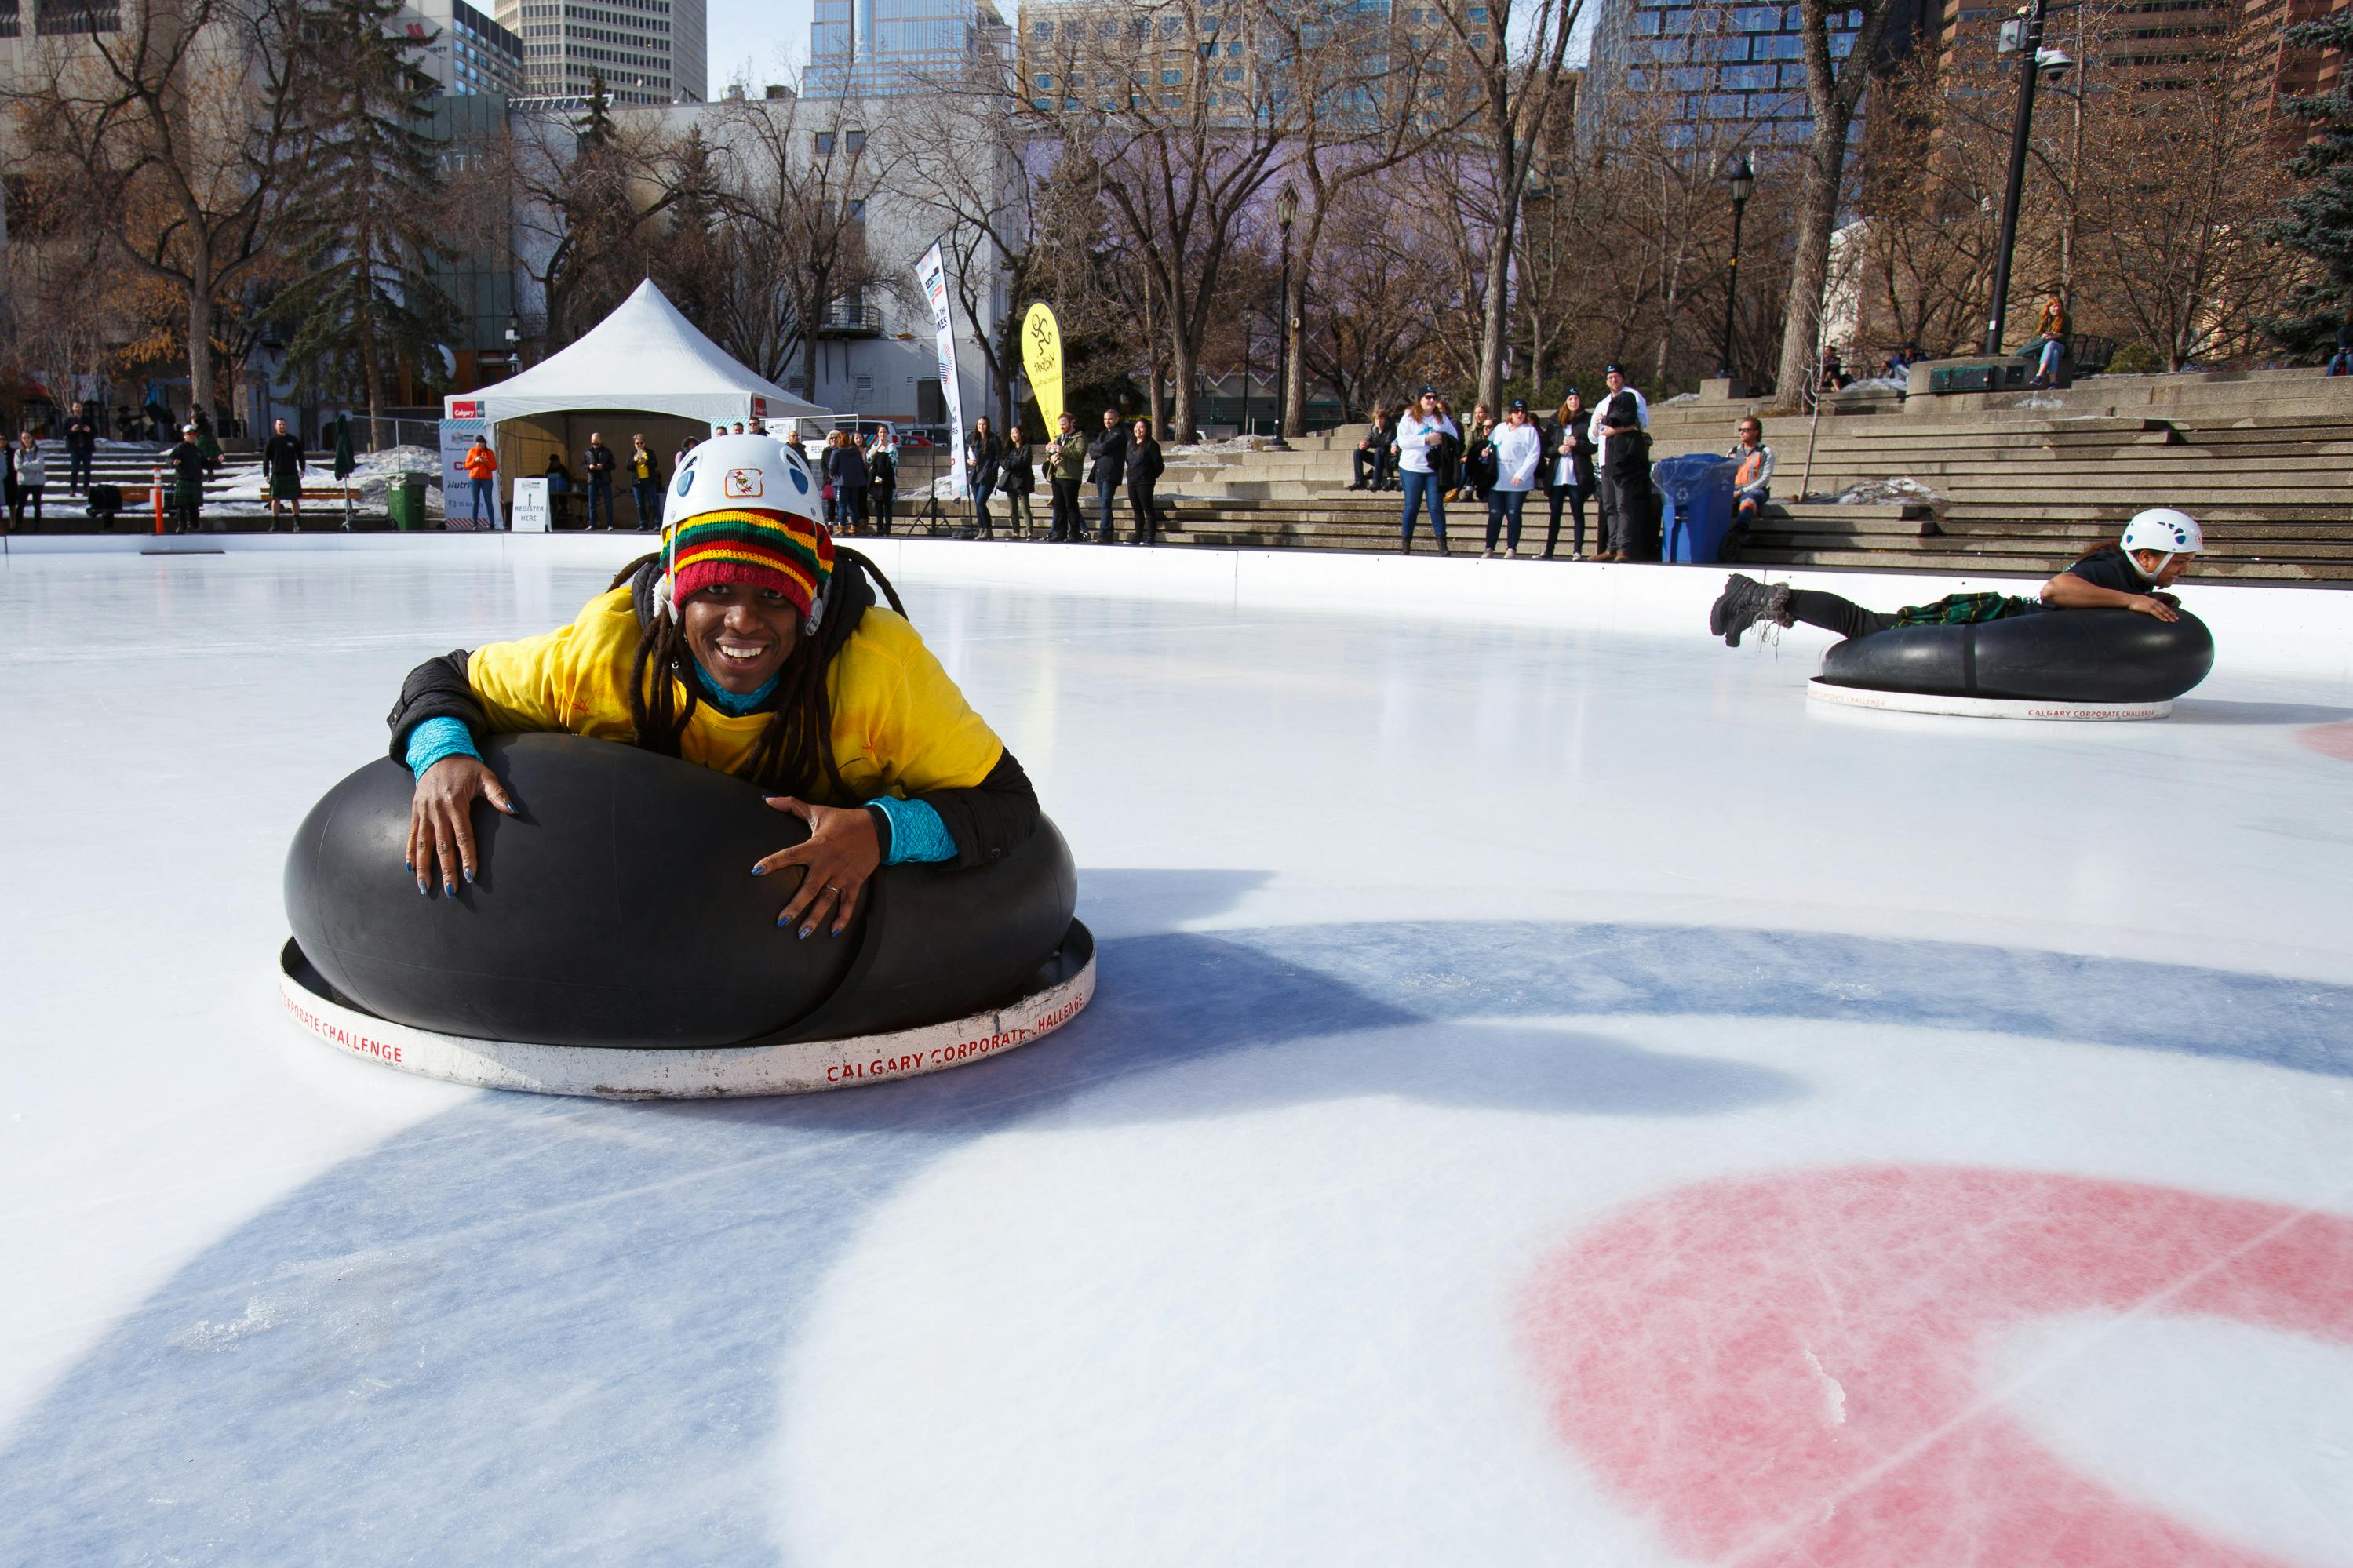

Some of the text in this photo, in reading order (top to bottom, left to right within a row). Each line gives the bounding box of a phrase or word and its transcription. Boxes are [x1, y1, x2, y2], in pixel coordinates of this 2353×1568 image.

[447, 480, 470, 489] Nutri
[322, 1022, 402, 1062] CHALLENGE
[827, 1052, 924, 1082] CALGARY
